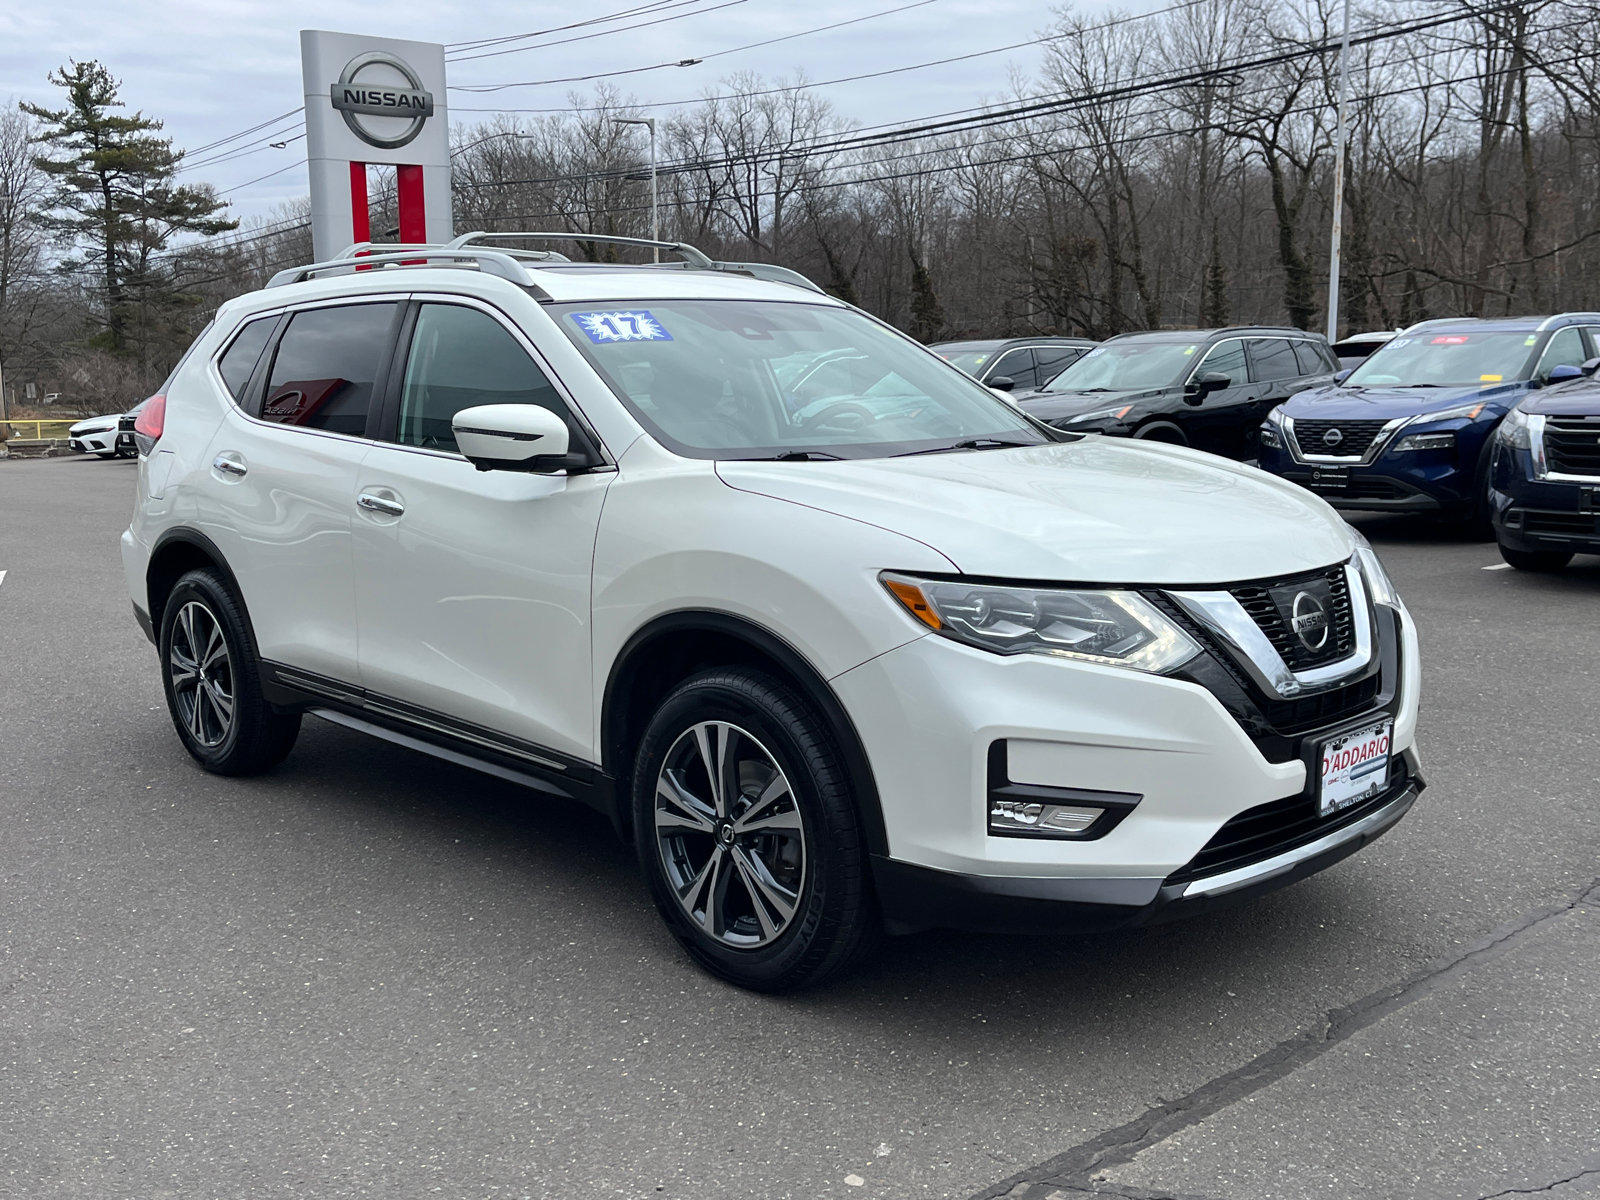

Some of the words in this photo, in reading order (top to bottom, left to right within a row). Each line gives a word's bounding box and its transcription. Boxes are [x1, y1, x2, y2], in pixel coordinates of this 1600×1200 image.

[343, 89, 426, 110] NISSAN
[599, 316, 640, 335] 17
[1297, 615, 1327, 629] NISSAN
[1322, 736, 1389, 777] D'ADDARIO
